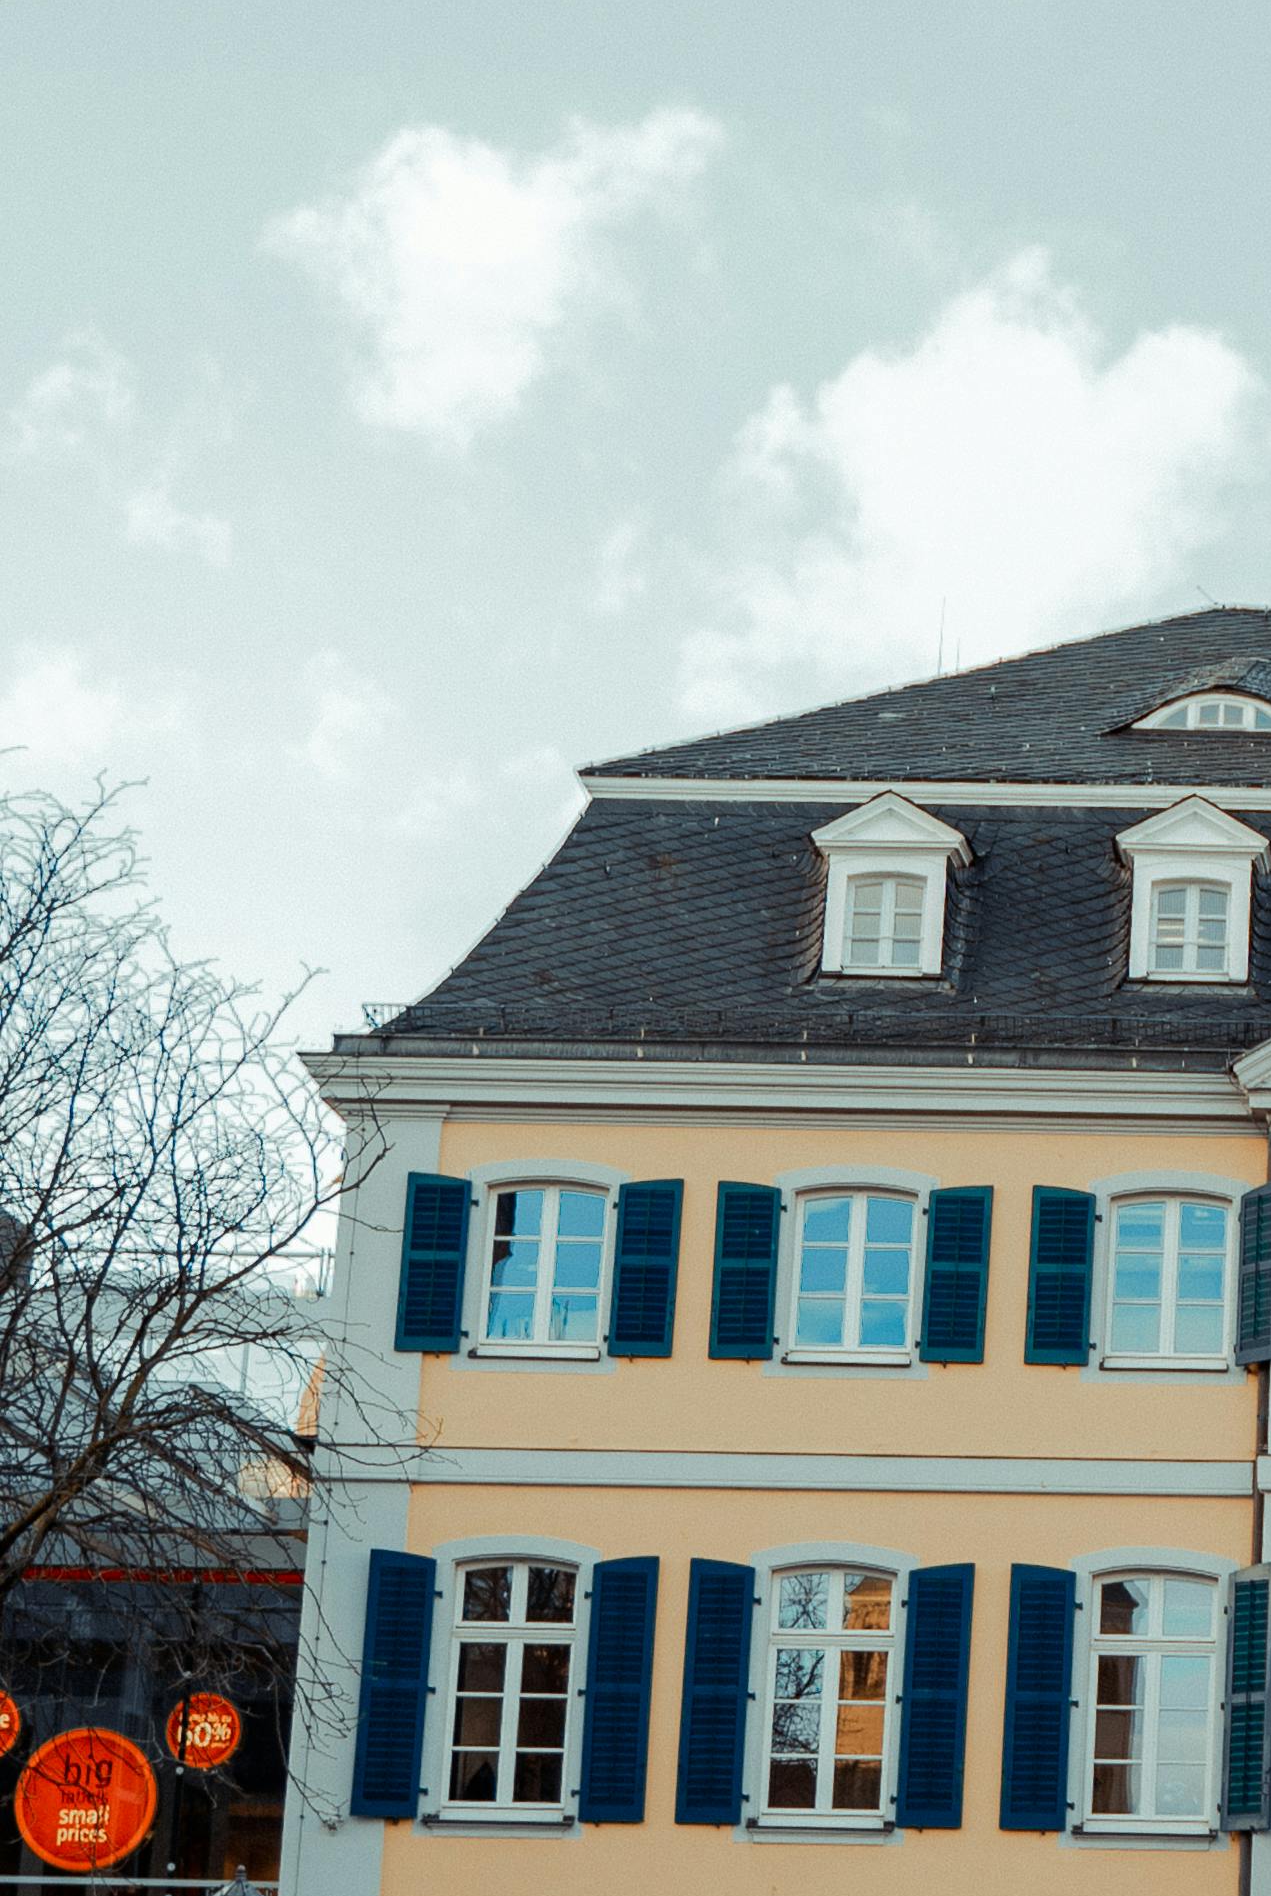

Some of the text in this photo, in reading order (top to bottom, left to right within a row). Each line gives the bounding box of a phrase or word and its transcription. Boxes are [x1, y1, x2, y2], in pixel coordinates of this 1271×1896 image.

[64, 1754, 112, 1788] big
[58, 1805, 109, 1825] small
[56, 1824, 107, 1847] prices
